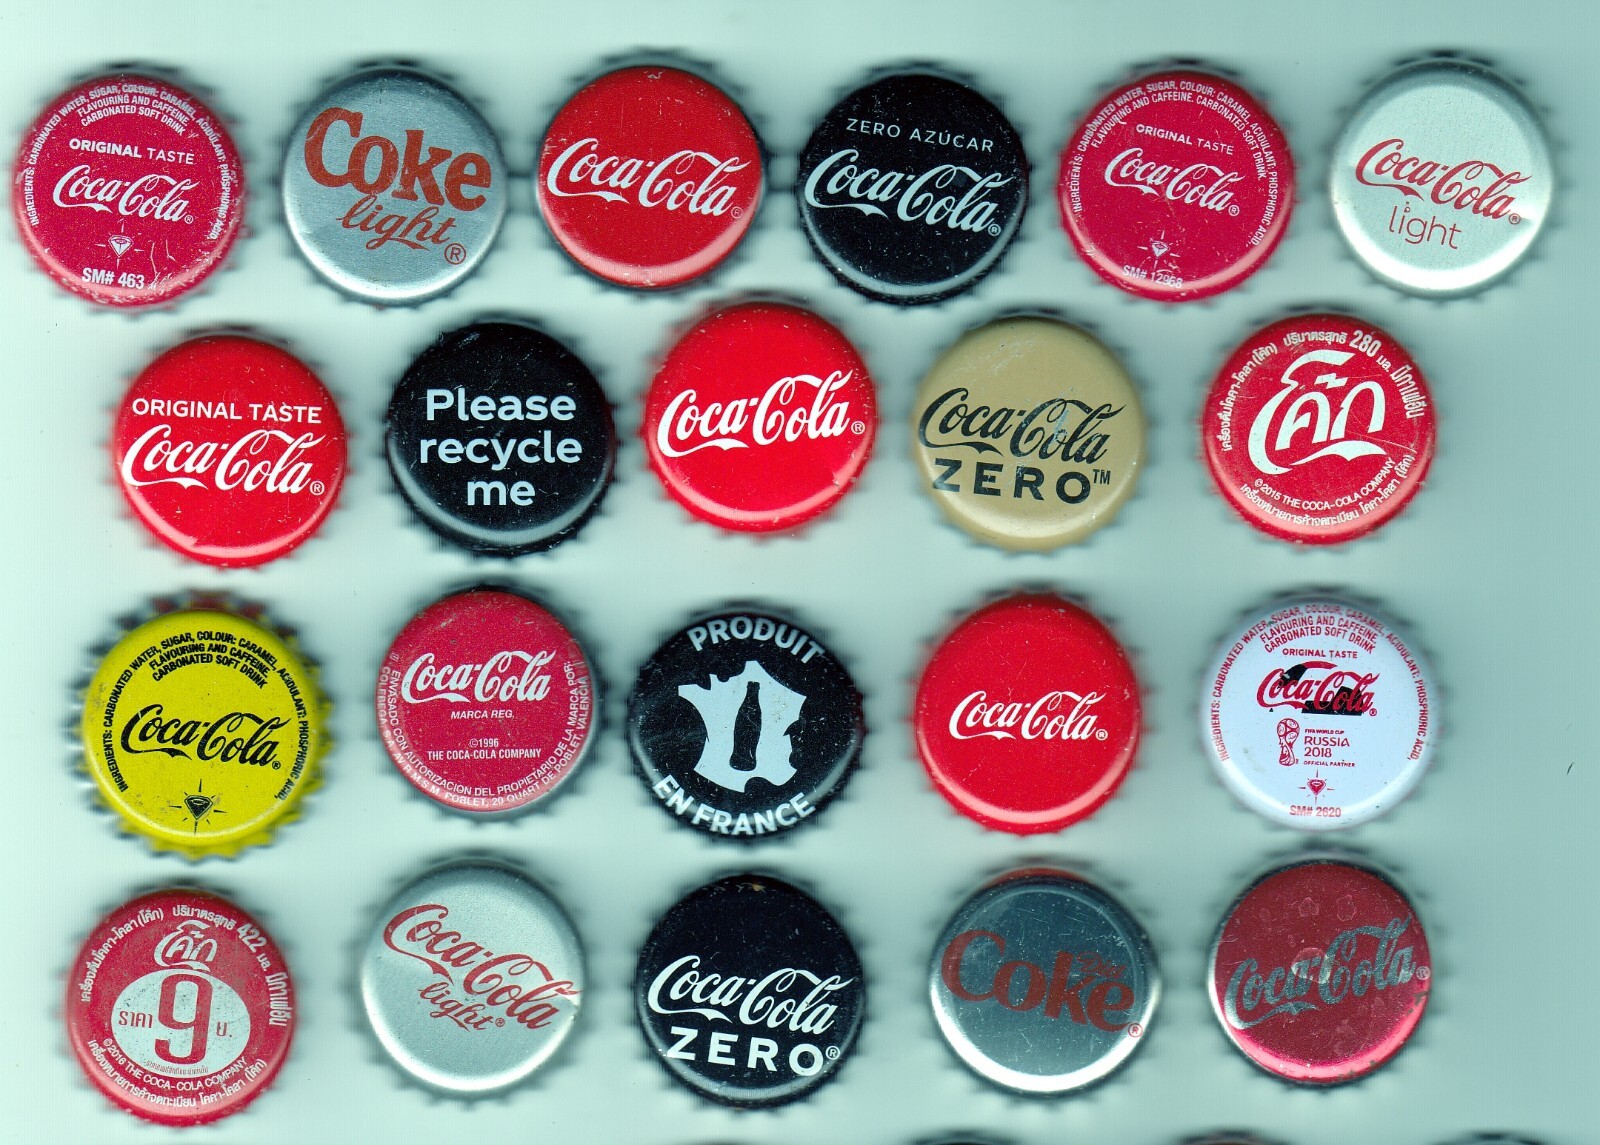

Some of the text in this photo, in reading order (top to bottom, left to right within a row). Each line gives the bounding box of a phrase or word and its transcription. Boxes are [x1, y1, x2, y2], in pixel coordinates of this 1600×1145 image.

[60, 95, 89, 117] WATER,
[77, 95, 130, 117] FLAVOURING
[132, 95, 150, 105] AND
[88, 85, 120, 100] SUGAR,
[121, 84, 158, 96] COLOUR:
[160, 91, 197, 120] CARAMEL,
[28, 115, 61, 165] CARBONATED
[80, 105, 186, 135] CARBONATED SOFT DRINK
[195, 116, 228, 163] ACIDULANT:
[846, 118, 994, 152] ZERO AZÚCAR
[1091, 106, 1132, 149] FLAVOURING
[1133, 96, 1150, 109] AND
[1151, 92, 1194, 102] CAFFEINE.
[1196, 95, 1245, 130] CARBONATED
[1242, 129, 1259, 150] SOFT
[1136, 124, 1234, 155] ORIGINAL TASTE
[69, 138, 195, 165] ORIGINAL TASTE
[304, 107, 492, 211] Coke
[1070, 155, 1084, 212] INGREDIENTS:
[1077, 103, 1116, 152] CARBONATED
[1116, 87, 1146, 106] WATER,
[1146, 81, 1177, 93] SUGAR,
[1180, 80, 1216, 96] COLOUR:
[1217, 93, 1251, 124] CARAMEL,
[1249, 122, 1276, 169] ACIDULANT:
[1265, 171, 1278, 226] PHOSPHORIC
[23, 166, 40, 226] INGREDIENTS:
[52, 164, 200, 222] Coca-Cola
[220, 163, 231, 221] PHOSPHORIC
[547, 137, 751, 216] Coca-Cola
[804, 149, 1015, 233] Coca-Cola
[1104, 148, 1246, 211] Coca-Cola
[1355, 138, 1533, 219] Coca-Cola
[335, 195, 457, 252] light
[1389, 201, 1461, 249] light
[82, 267, 145, 289] SM# 463
[1123, 265, 1147, 280] SM#
[1349, 330, 1382, 357] 280
[132, 398, 322, 424] ORIGINAL TASTE
[426, 388, 576, 421] Please
[657, 370, 853, 458] Coca-Cola
[918, 387, 1126, 464] Coca-Cola
[121, 424, 326, 494] Coca-Cola
[420, 430, 583, 470] recycle
[467, 480, 535, 506] me
[1282, 496, 1301, 508] THE
[1302, 492, 1360, 510] COCA-COLA
[1360, 457, 1396, 496] COMPANY
[687, 616, 825, 664] PRODUIT
[1260, 616, 1334, 643] FLAVOURING AND
[1265, 626, 1376, 654] CARBONATED SOFT DRINK
[1282, 648, 1358, 658] ORIGINAL TASTE
[149, 643, 205, 670] FLAVOURING
[207, 644, 228, 653] AND
[152, 654, 268, 689] CARBONATED SOFT DRINK
[401, 651, 556, 703] Coca-Cola
[103, 631, 309, 793] INGREDIENTS: CARBONATED WATER, SUGAR, COLOUR: CARAMEL, ACIDULANT: PHOSPHORIC
[451, 709, 515, 719] MARCA REG.
[1211, 633, 1428, 761] INGREDIENTS: CARBONATED ACIDULANT: PHOSPHORIC
[1257, 667, 1380, 713] Coca-Cola
[121, 704, 292, 766] Coca-Cola
[388, 661, 579, 796] ENVASADO CON AUTORIZACION DEL PROPIETARIO DE LA MARCA POR:
[949, 691, 1106, 740] Coca-Cola
[428, 748, 541, 760] THE COCA-COLA COMPANY
[1304, 736, 1350, 747] RUSSIA
[1304, 747, 1332, 757] 2018
[492, 798, 504, 806] 20
[507, 782, 540, 802] QUART
[542, 773, 556, 785] DE
[652, 774, 816, 835] EN FRANCE
[1290, 805, 1341, 817] SM# 2620
[237, 923, 267, 953] 422
[383, 903, 584, 1029] Coca-Cola
[941, 930, 1135, 1032] Coke
[1224, 914, 1416, 1030] Coca-Cola
[155, 973, 213, 1065] 9
[417, 982, 493, 1032] light
[648, 955, 856, 1035] Coca-Cola
[126, 1062, 142, 1079] THE
[205, 1056, 248, 1087] COMPANY
[666, 1026, 824, 1076] ZERO
